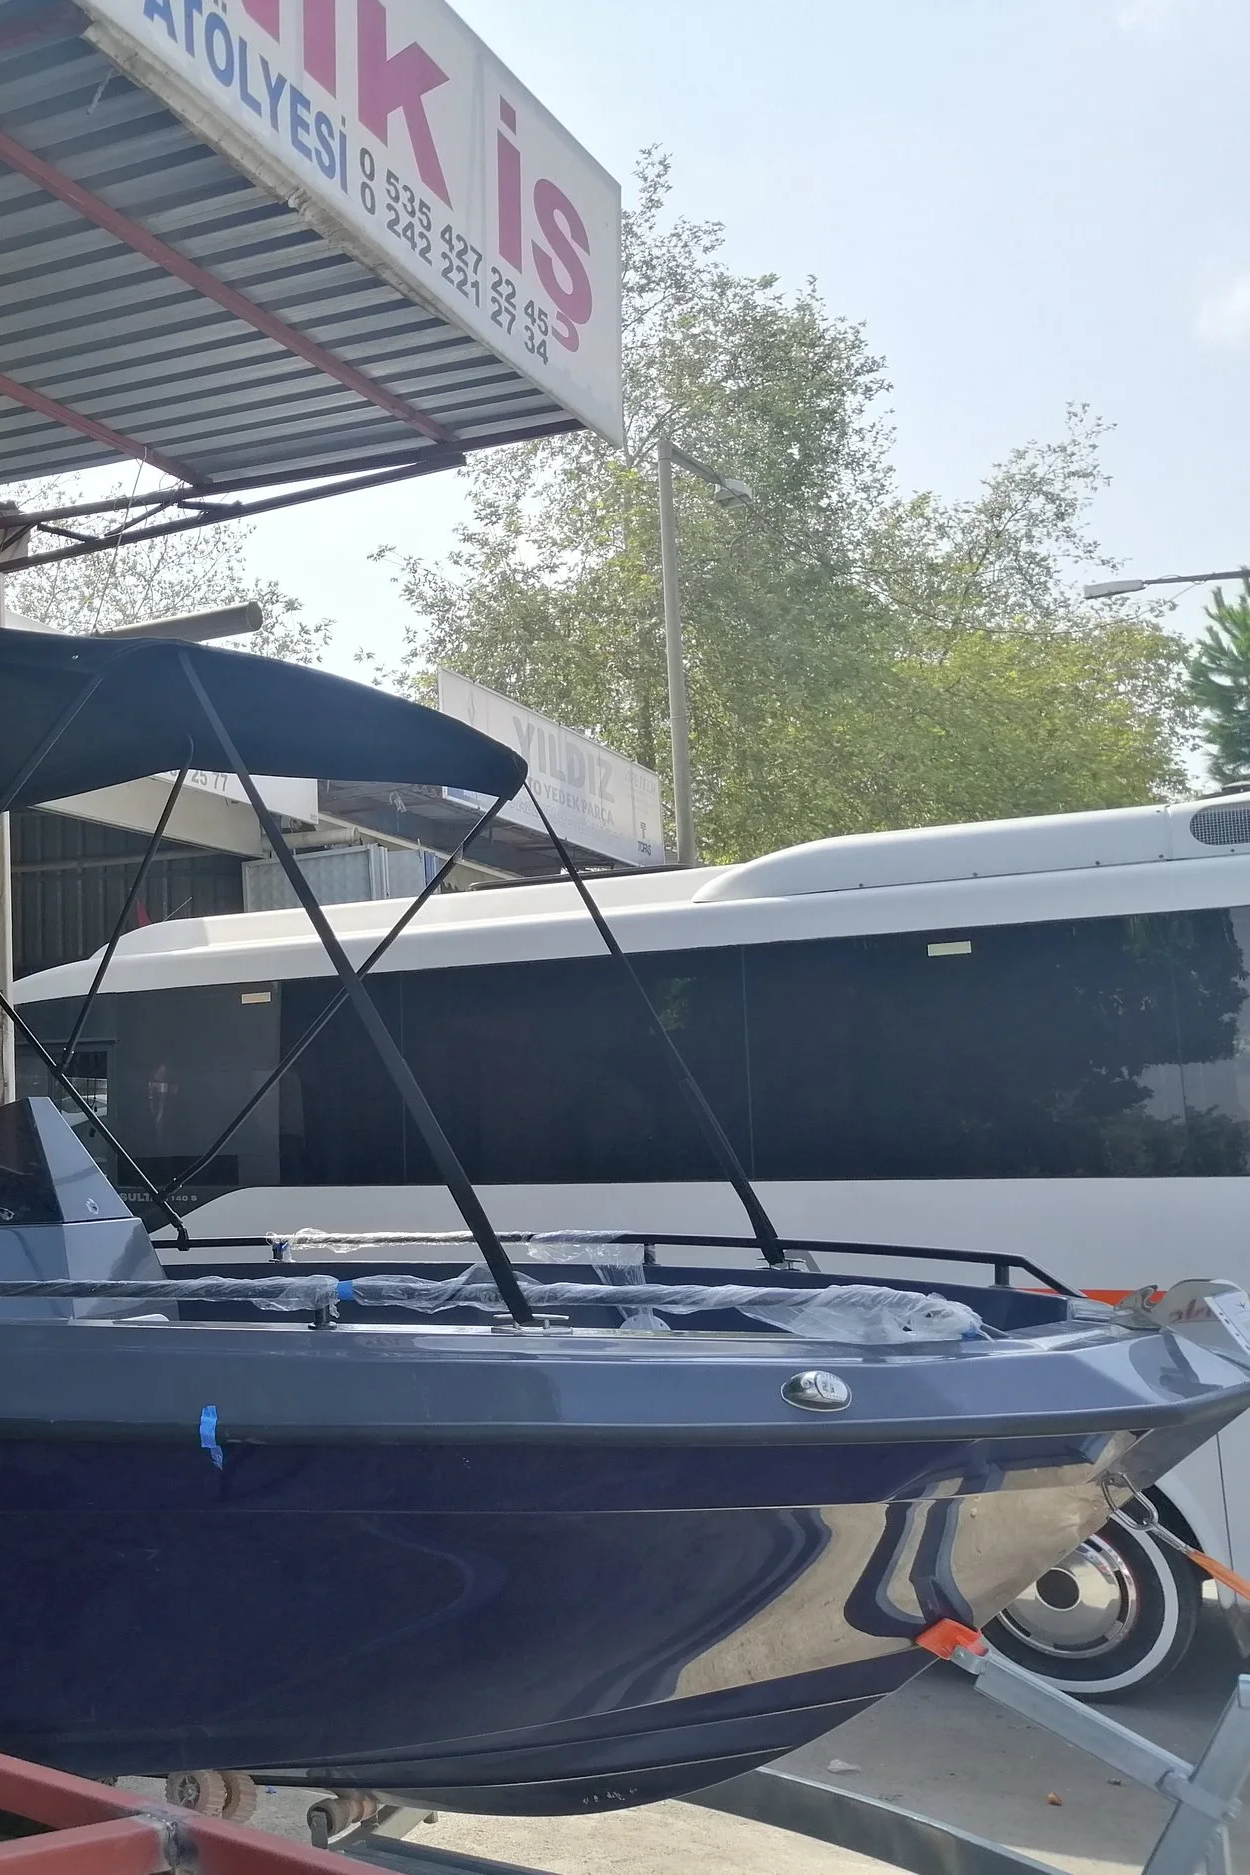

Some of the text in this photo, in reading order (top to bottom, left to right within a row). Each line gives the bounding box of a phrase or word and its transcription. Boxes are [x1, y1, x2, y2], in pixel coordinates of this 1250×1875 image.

[359, 147, 549, 337] 0 535 427 22 45
[360, 181, 549, 366] 0 242 221 27 34
[213, 772, 228, 791] 77
[513, 715, 615, 804] YILDIZ
[544, 782, 581, 813] YEDEK
